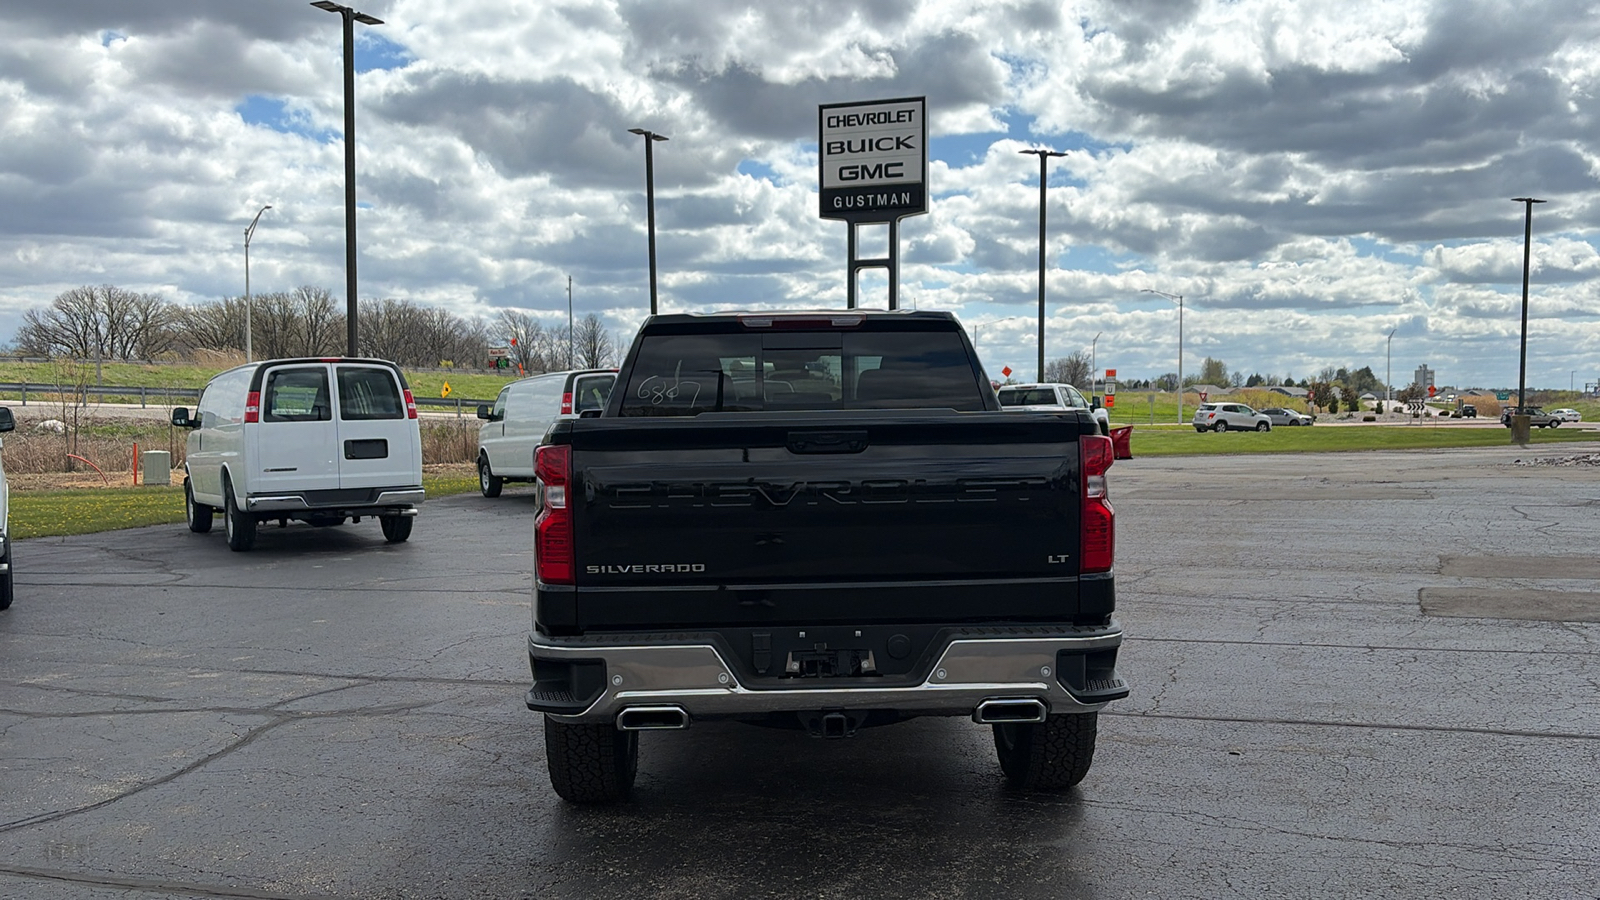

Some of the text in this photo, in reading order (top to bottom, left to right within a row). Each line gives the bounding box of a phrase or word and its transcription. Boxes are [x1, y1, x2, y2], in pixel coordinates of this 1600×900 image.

[827, 109, 915, 128] CHEVROLET
[826, 134, 916, 155] BUICK
[838, 162, 904, 181] GMC
[833, 192, 910, 208] GUSTMAN
[1048, 554, 1070, 563] LT
[586, 564, 706, 574] SILVERADO
